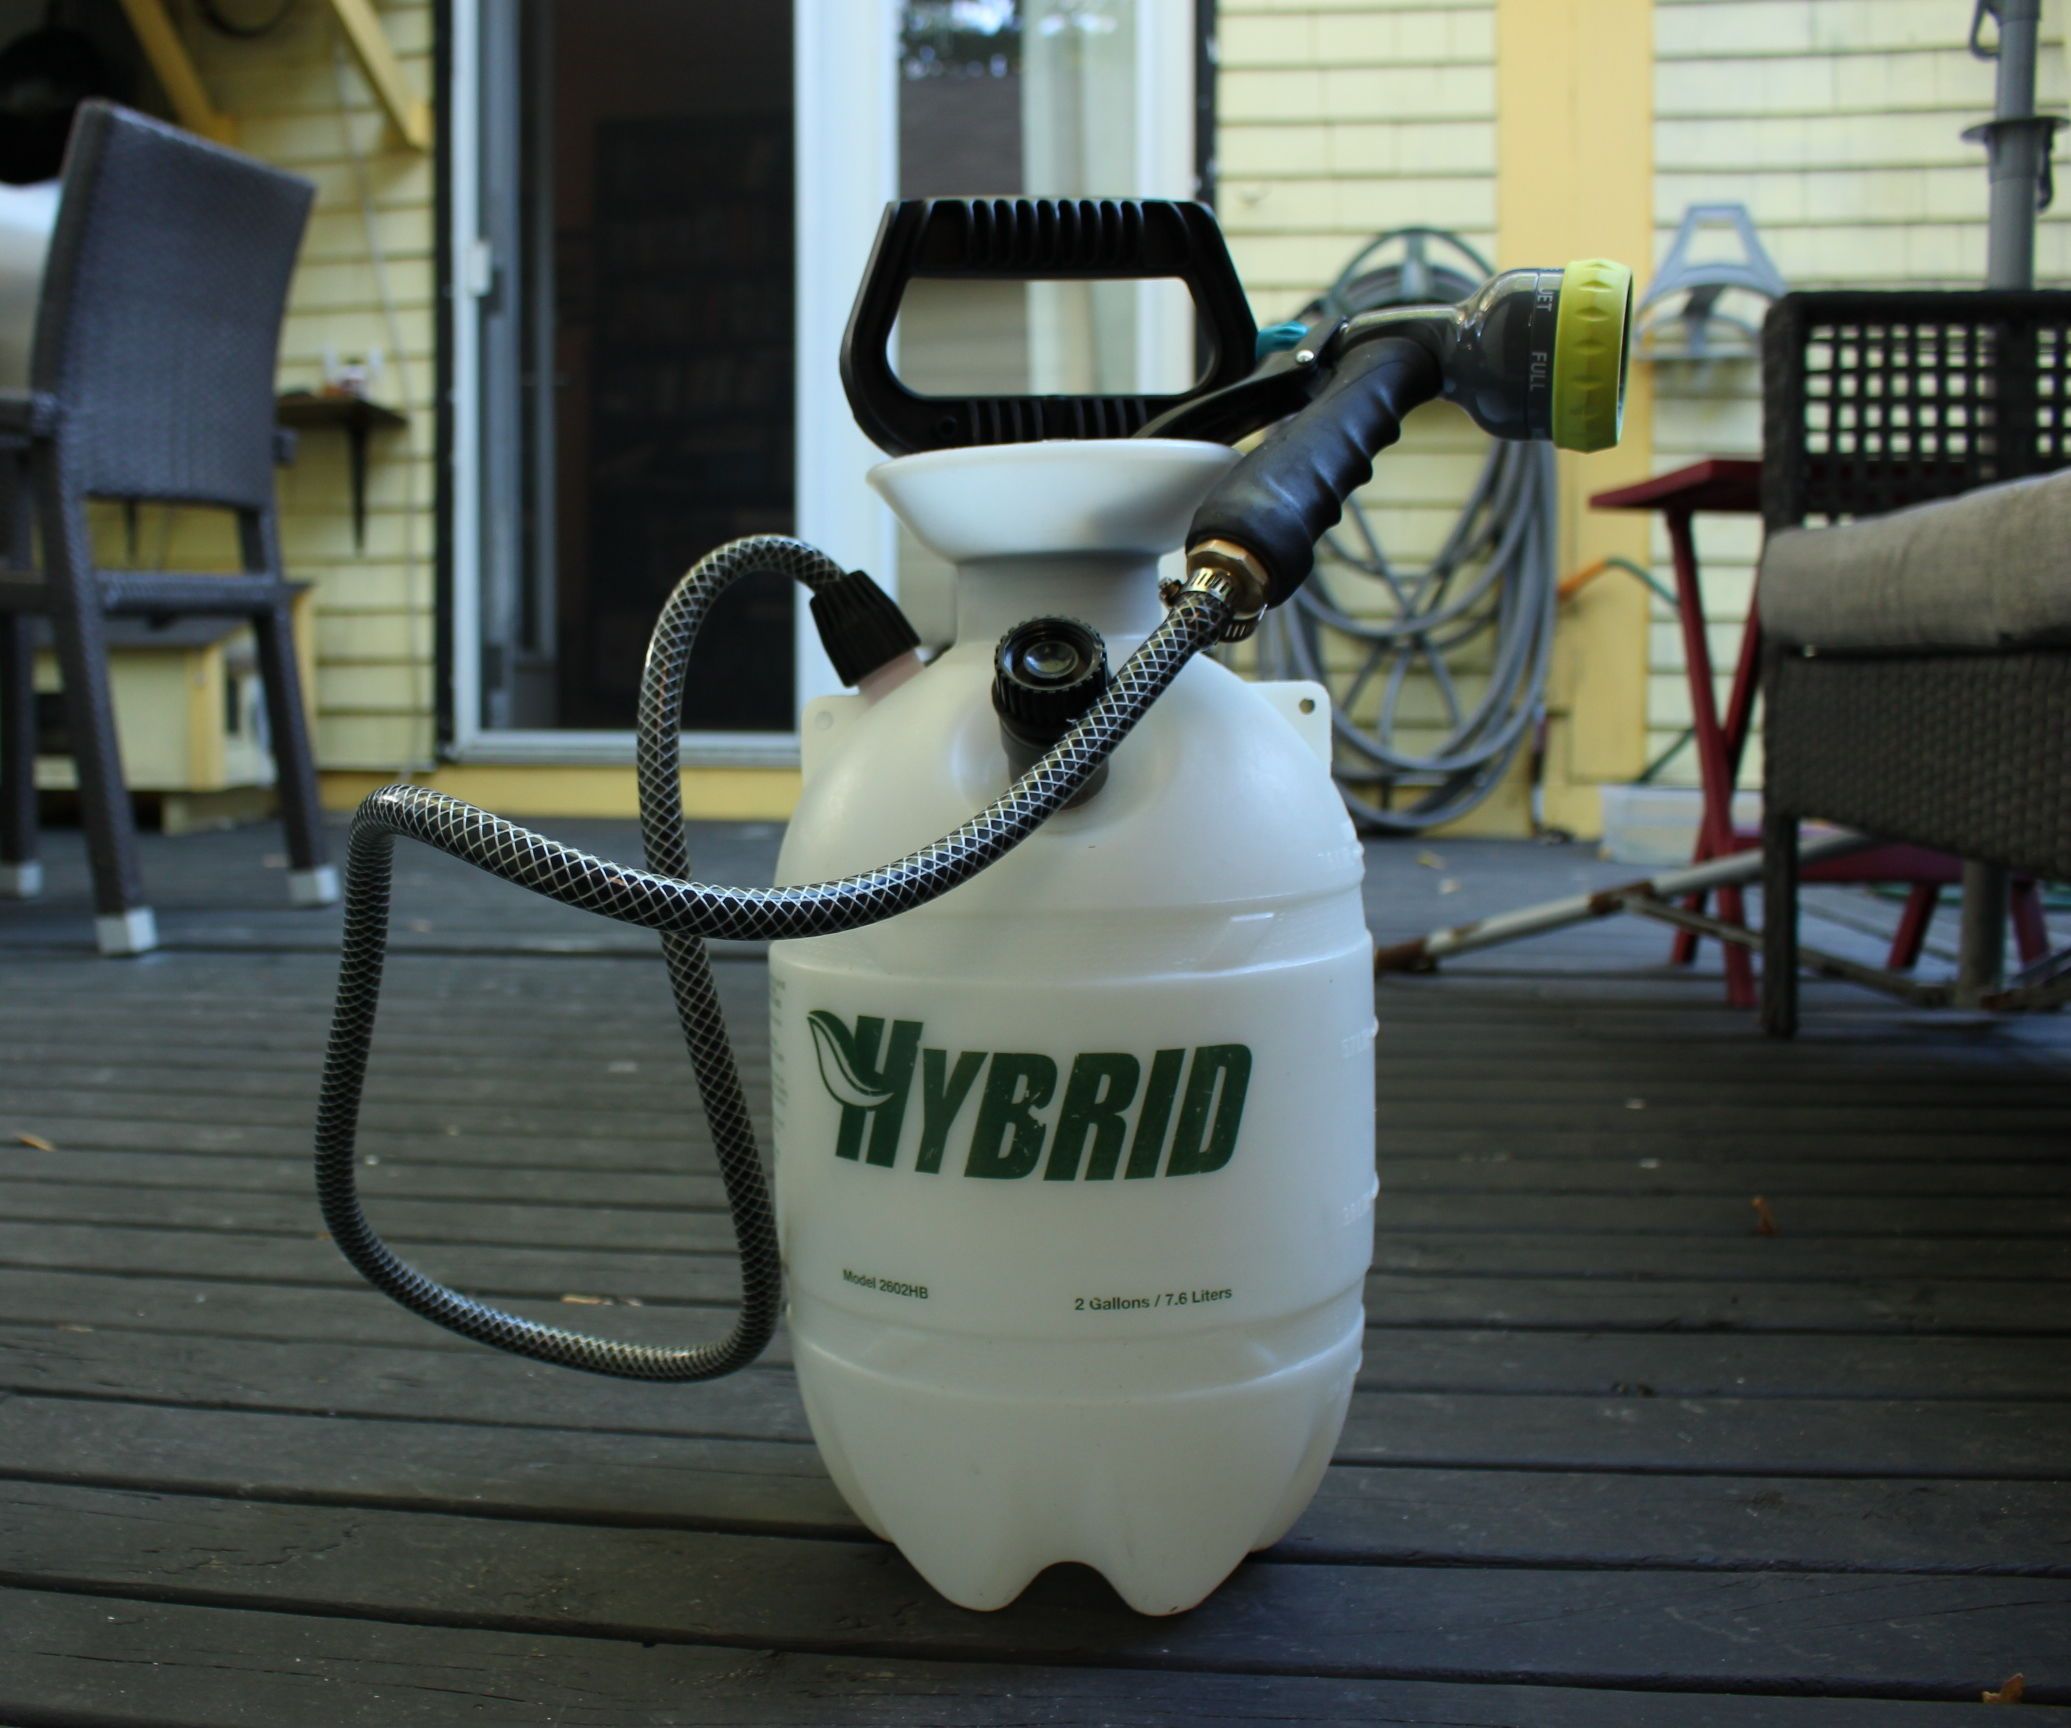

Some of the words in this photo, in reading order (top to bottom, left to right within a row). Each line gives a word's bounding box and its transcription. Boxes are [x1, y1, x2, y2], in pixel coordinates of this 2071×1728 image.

[1536, 287, 1553, 312] JET
[1530, 352, 1548, 391] FULL
[834, 1015, 1252, 1181] HYBRID
[843, 1269, 877, 1289] Model
[879, 1279, 929, 1300] 2602HB
[1075, 1298, 1085, 1311] 2
[1089, 1297, 1150, 1311] Gallons
[1165, 1292, 1188, 1306] 7.6
[1192, 1288, 1232, 1304] Liters
